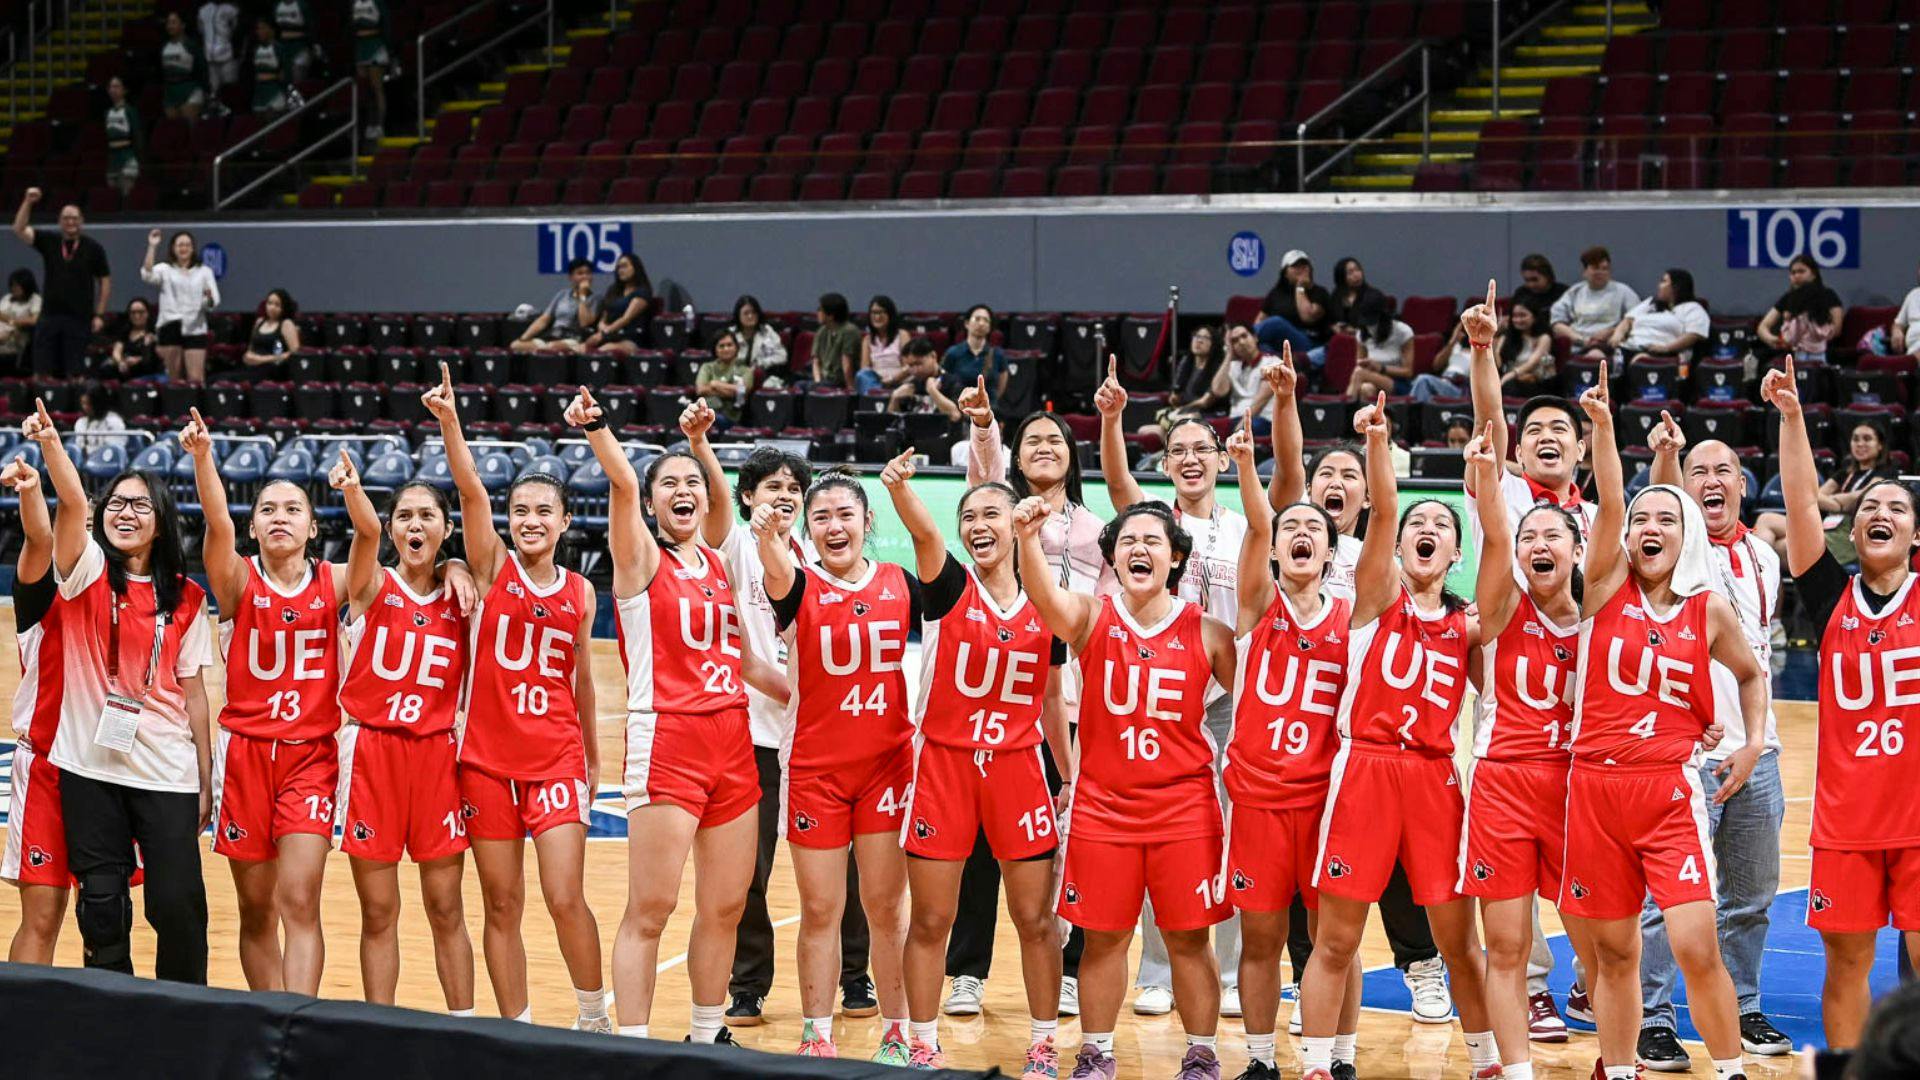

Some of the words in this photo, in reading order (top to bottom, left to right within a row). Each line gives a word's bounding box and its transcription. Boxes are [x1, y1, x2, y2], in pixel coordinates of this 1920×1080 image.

[547, 223, 623, 272] 105
[1739, 209, 1847, 268] 106
[494, 614, 573, 678] UE
[679, 598, 741, 659] UE
[249, 629, 326, 680] UE
[372, 626, 456, 689] UE
[820, 620, 901, 675] UE
[955, 642, 1038, 705] UE
[1256, 649, 1342, 716] UE
[1381, 632, 1459, 710] UE
[1607, 637, 1694, 709] UE
[1833, 646, 1920, 710] UE
[268, 691, 300, 721] 13
[387, 692, 423, 723] 18
[512, 683, 548, 715] 10
[840, 683, 887, 716] 44
[1104, 660, 1186, 721] UE
[969, 710, 1008, 744] 15
[1268, 718, 1308, 754] 19
[1398, 705, 1418, 740] 2
[1629, 711, 1657, 738] 4
[1856, 719, 1903, 756] 26
[1120, 726, 1159, 760] 16
[305, 795, 332, 822] 13
[537, 783, 569, 814] 10
[1019, 805, 1051, 841] 15
[1679, 855, 1701, 884] 4
